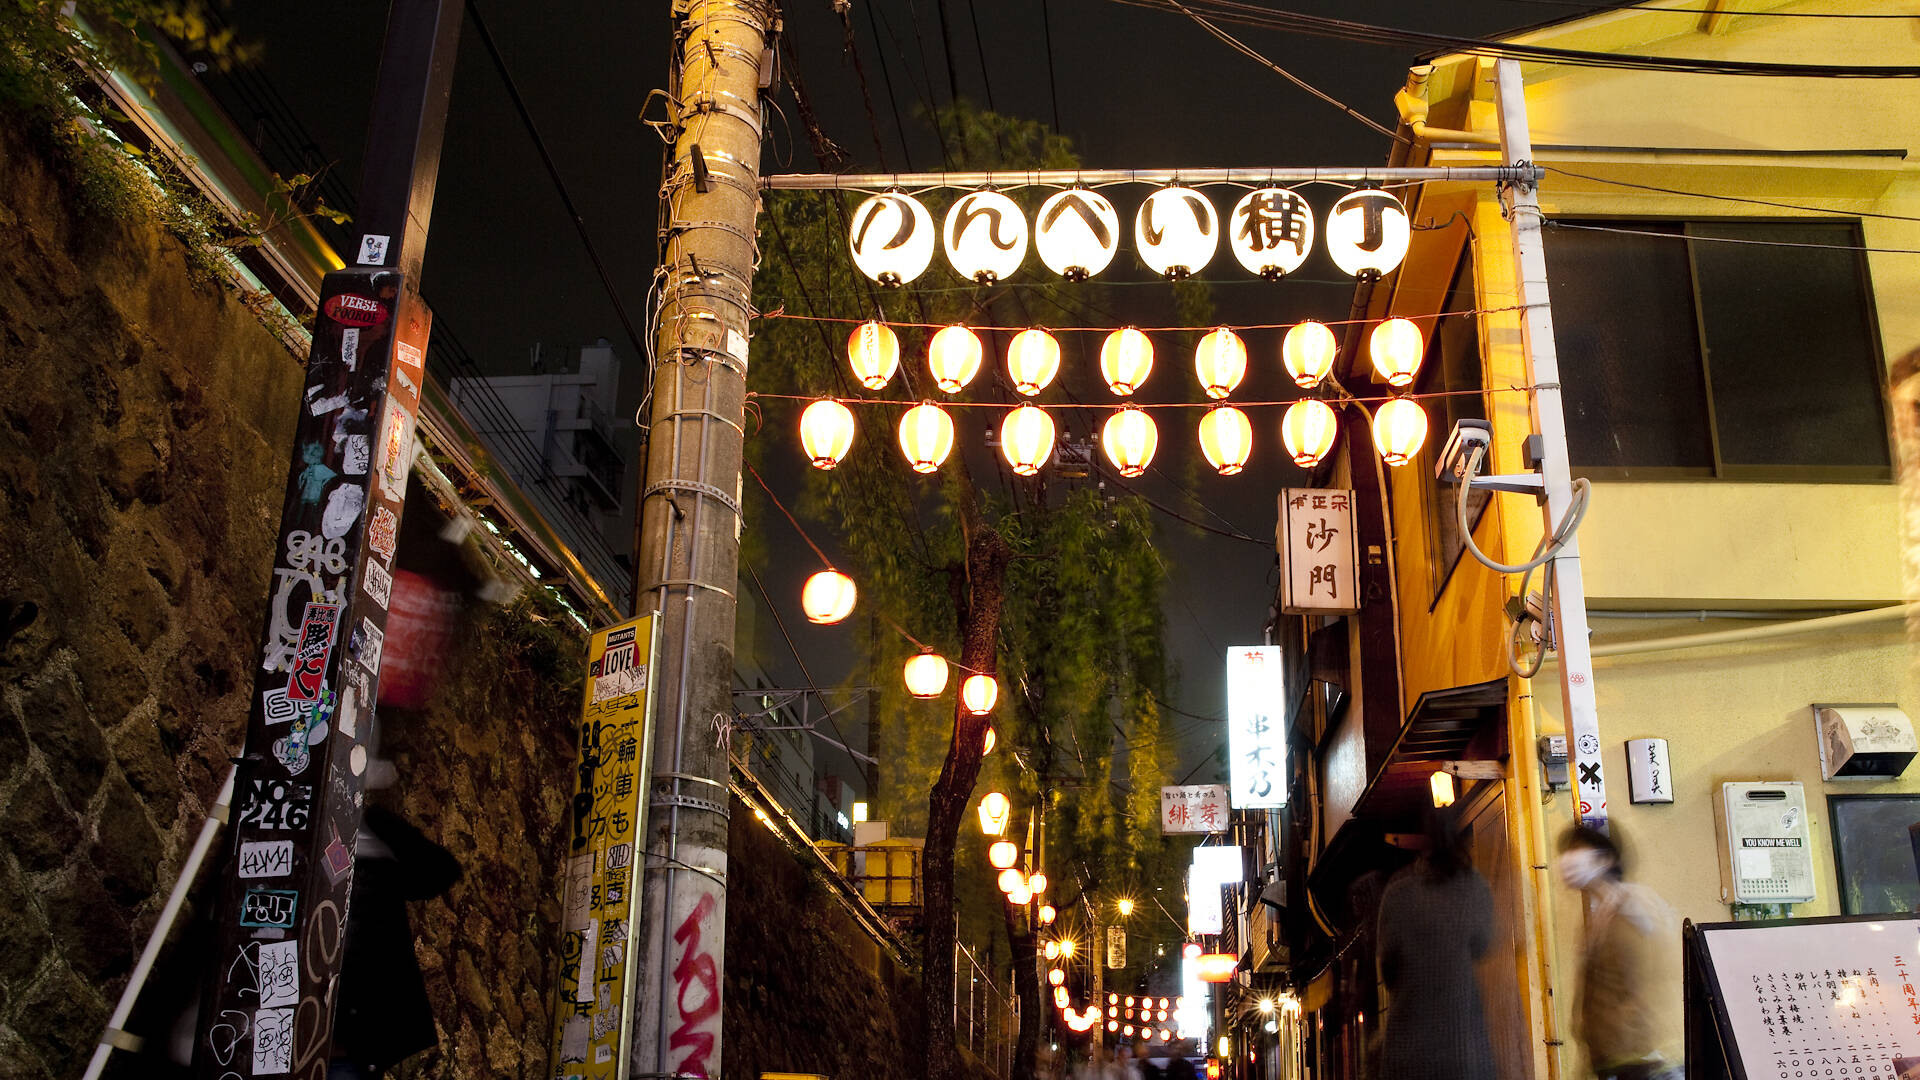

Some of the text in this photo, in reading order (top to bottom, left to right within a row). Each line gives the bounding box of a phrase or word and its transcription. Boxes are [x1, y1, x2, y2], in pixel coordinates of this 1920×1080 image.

[851, 192, 1406, 256] のんべい横丁
[340, 295, 378, 312] VERSE
[1306, 517, 1339, 599] 沙門
[608, 630, 635, 642] MUTANTS
[604, 648, 632, 676] LOVE
[240, 801, 308, 830] 246
[1745, 839, 1800, 847] YOU KNOW ME WELL
